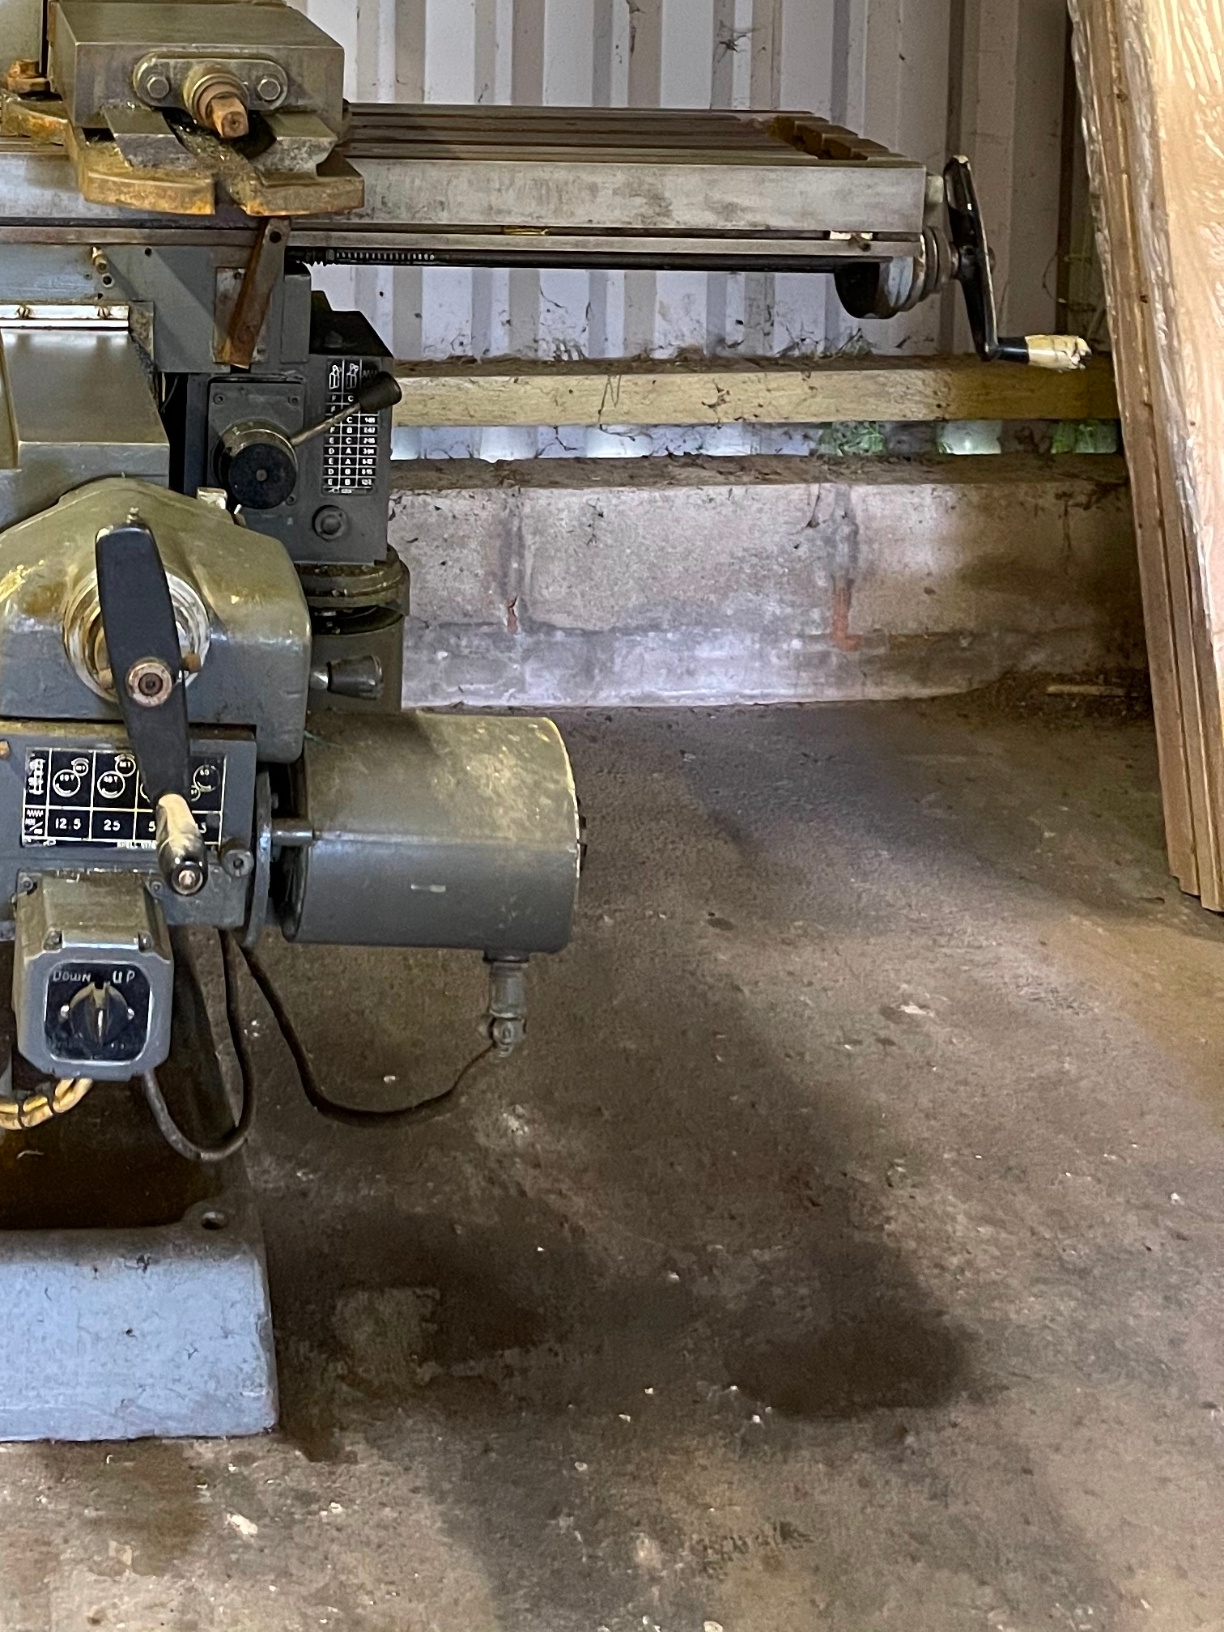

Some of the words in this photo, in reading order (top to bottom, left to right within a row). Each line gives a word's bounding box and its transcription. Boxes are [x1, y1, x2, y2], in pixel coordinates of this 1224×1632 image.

[55, 818, 81, 829] 12.5
[103, 819, 121, 831] 25
[52, 970, 92, 982] DOWN
[112, 970, 136, 984] UP
